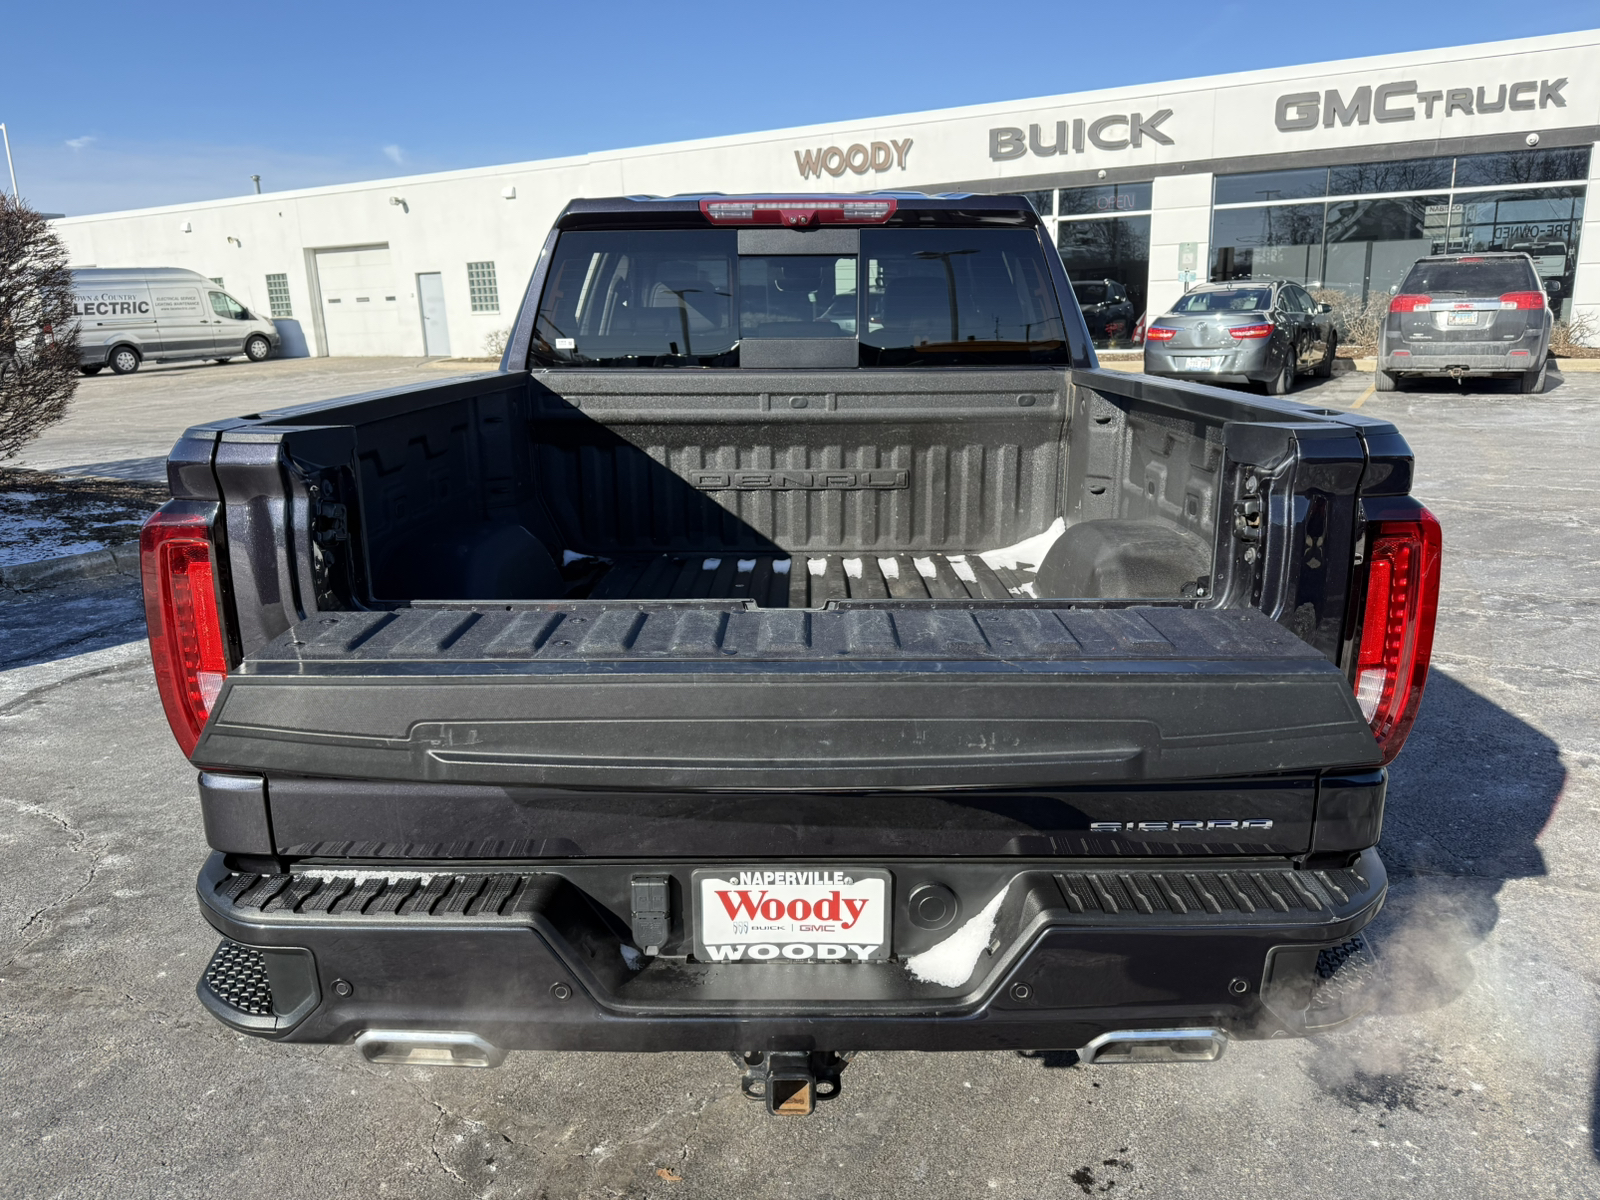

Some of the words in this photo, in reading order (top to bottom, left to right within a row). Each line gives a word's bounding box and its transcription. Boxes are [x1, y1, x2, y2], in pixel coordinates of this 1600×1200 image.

[1275, 80, 1417, 132] GMC
[1416, 76, 1569, 119] TRUCK
[988, 109, 1175, 161] BUICK
[794, 138, 914, 179] WOODY
[1096, 193, 1136, 210] OPEN
[101, 293, 137, 301] COUNTRY
[73, 301, 150, 316] LECTRIC
[693, 472, 907, 487] DENALI
[1089, 818, 1274, 832] SIERRA
[739, 871, 844, 885] NAPERVILLE
[714, 890, 870, 929] Woody
[799, 924, 836, 932] GMC
[705, 944, 879, 960] WOODY
